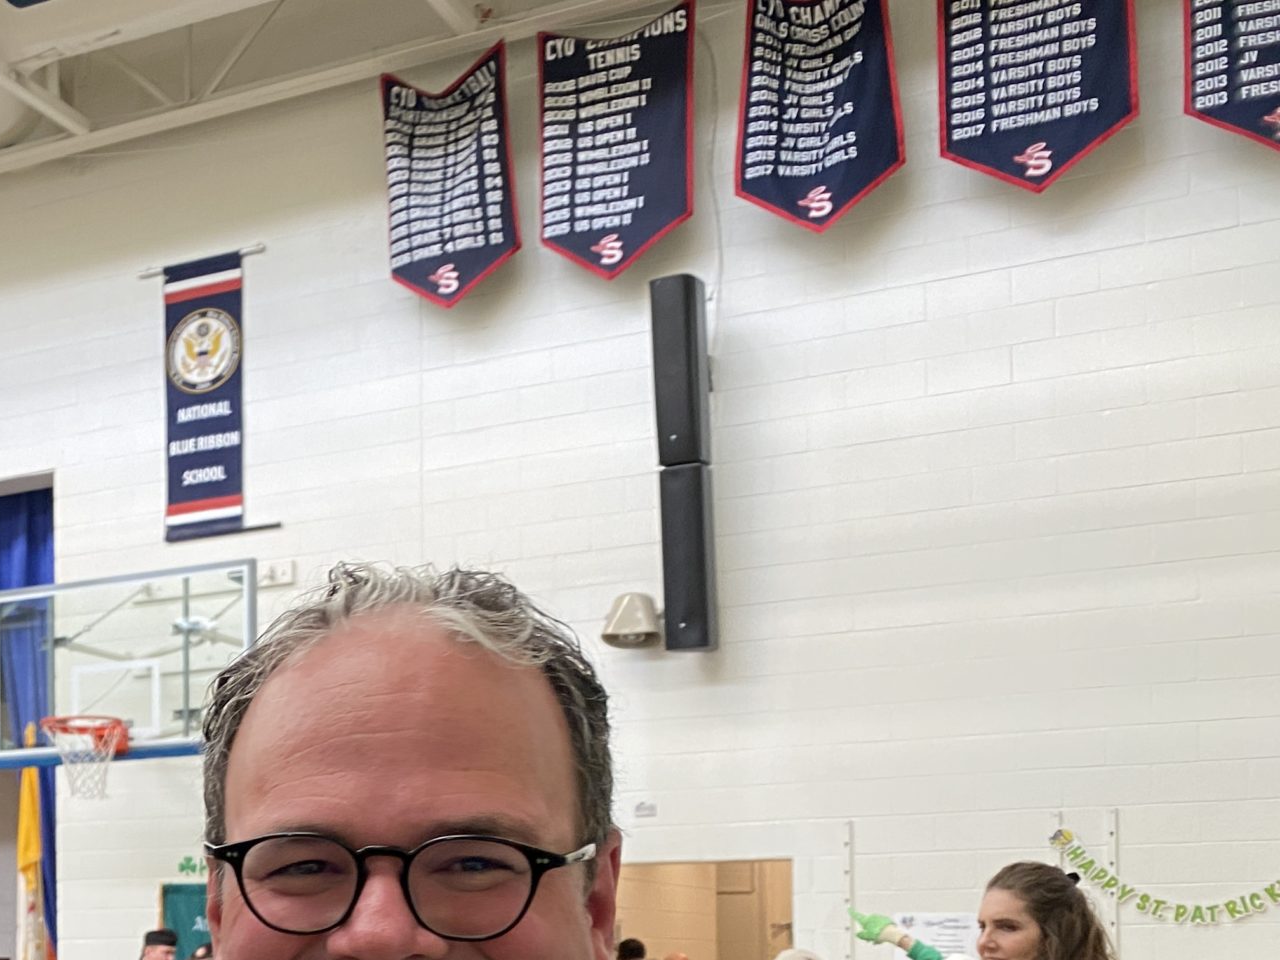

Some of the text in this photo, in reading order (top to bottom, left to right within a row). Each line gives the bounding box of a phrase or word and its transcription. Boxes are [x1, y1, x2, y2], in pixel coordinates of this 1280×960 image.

[951, 12, 982, 30] 2012
[951, 3, 1081, 46] 2012 VARSITY BOYS
[1196, 7, 1222, 24] 2011
[790, 24, 829, 43] CROSS
[951, 18, 1096, 62] 2013 FRESHMAN BOYS
[1196, 24, 1222, 41] 2011
[545, 38, 576, 61] CYO
[587, 44, 641, 70] TENNIS
[753, 47, 834, 69] 2011 JV GIRLS
[952, 34, 1096, 78] 2014 FRESHMAN BOYS
[1196, 39, 1228, 58] 2012
[752, 61, 781, 76] 2011
[785, 67, 830, 82] VARSITY
[1196, 50, 1259, 75] 2012 JV
[608, 66, 632, 81] CUP
[952, 55, 1081, 94] 2014 VARSITY BOYS
[1196, 74, 1228, 92] 2013
[782, 94, 799, 104] JV
[800, 92, 834, 106] GIRLS
[951, 71, 1081, 110] 2015 VARSITY BOYS
[1196, 91, 1228, 109] 2013
[748, 105, 779, 119] 2014
[782, 108, 799, 119] JV
[800, 106, 834, 119] GIRLS
[951, 87, 1081, 125] 2016 VARSITY BOYS
[747, 120, 828, 135] 2014 VARSITY
[951, 98, 1099, 141] 2017 FRESHMAN BOYS
[746, 132, 830, 149] 2015 JV GIRLS
[744, 146, 858, 180] 2017 VARSITY GIRLS
[745, 150, 776, 164] 2015
[780, 149, 825, 162] VARSITY
[177, 400, 232, 424] NATIONAL
[169, 430, 240, 457] BLUE RIBBON
[182, 465, 227, 486] SCHOOL
[1066, 846, 1135, 901] HAPPY
[1136, 893, 1167, 918] ST.
